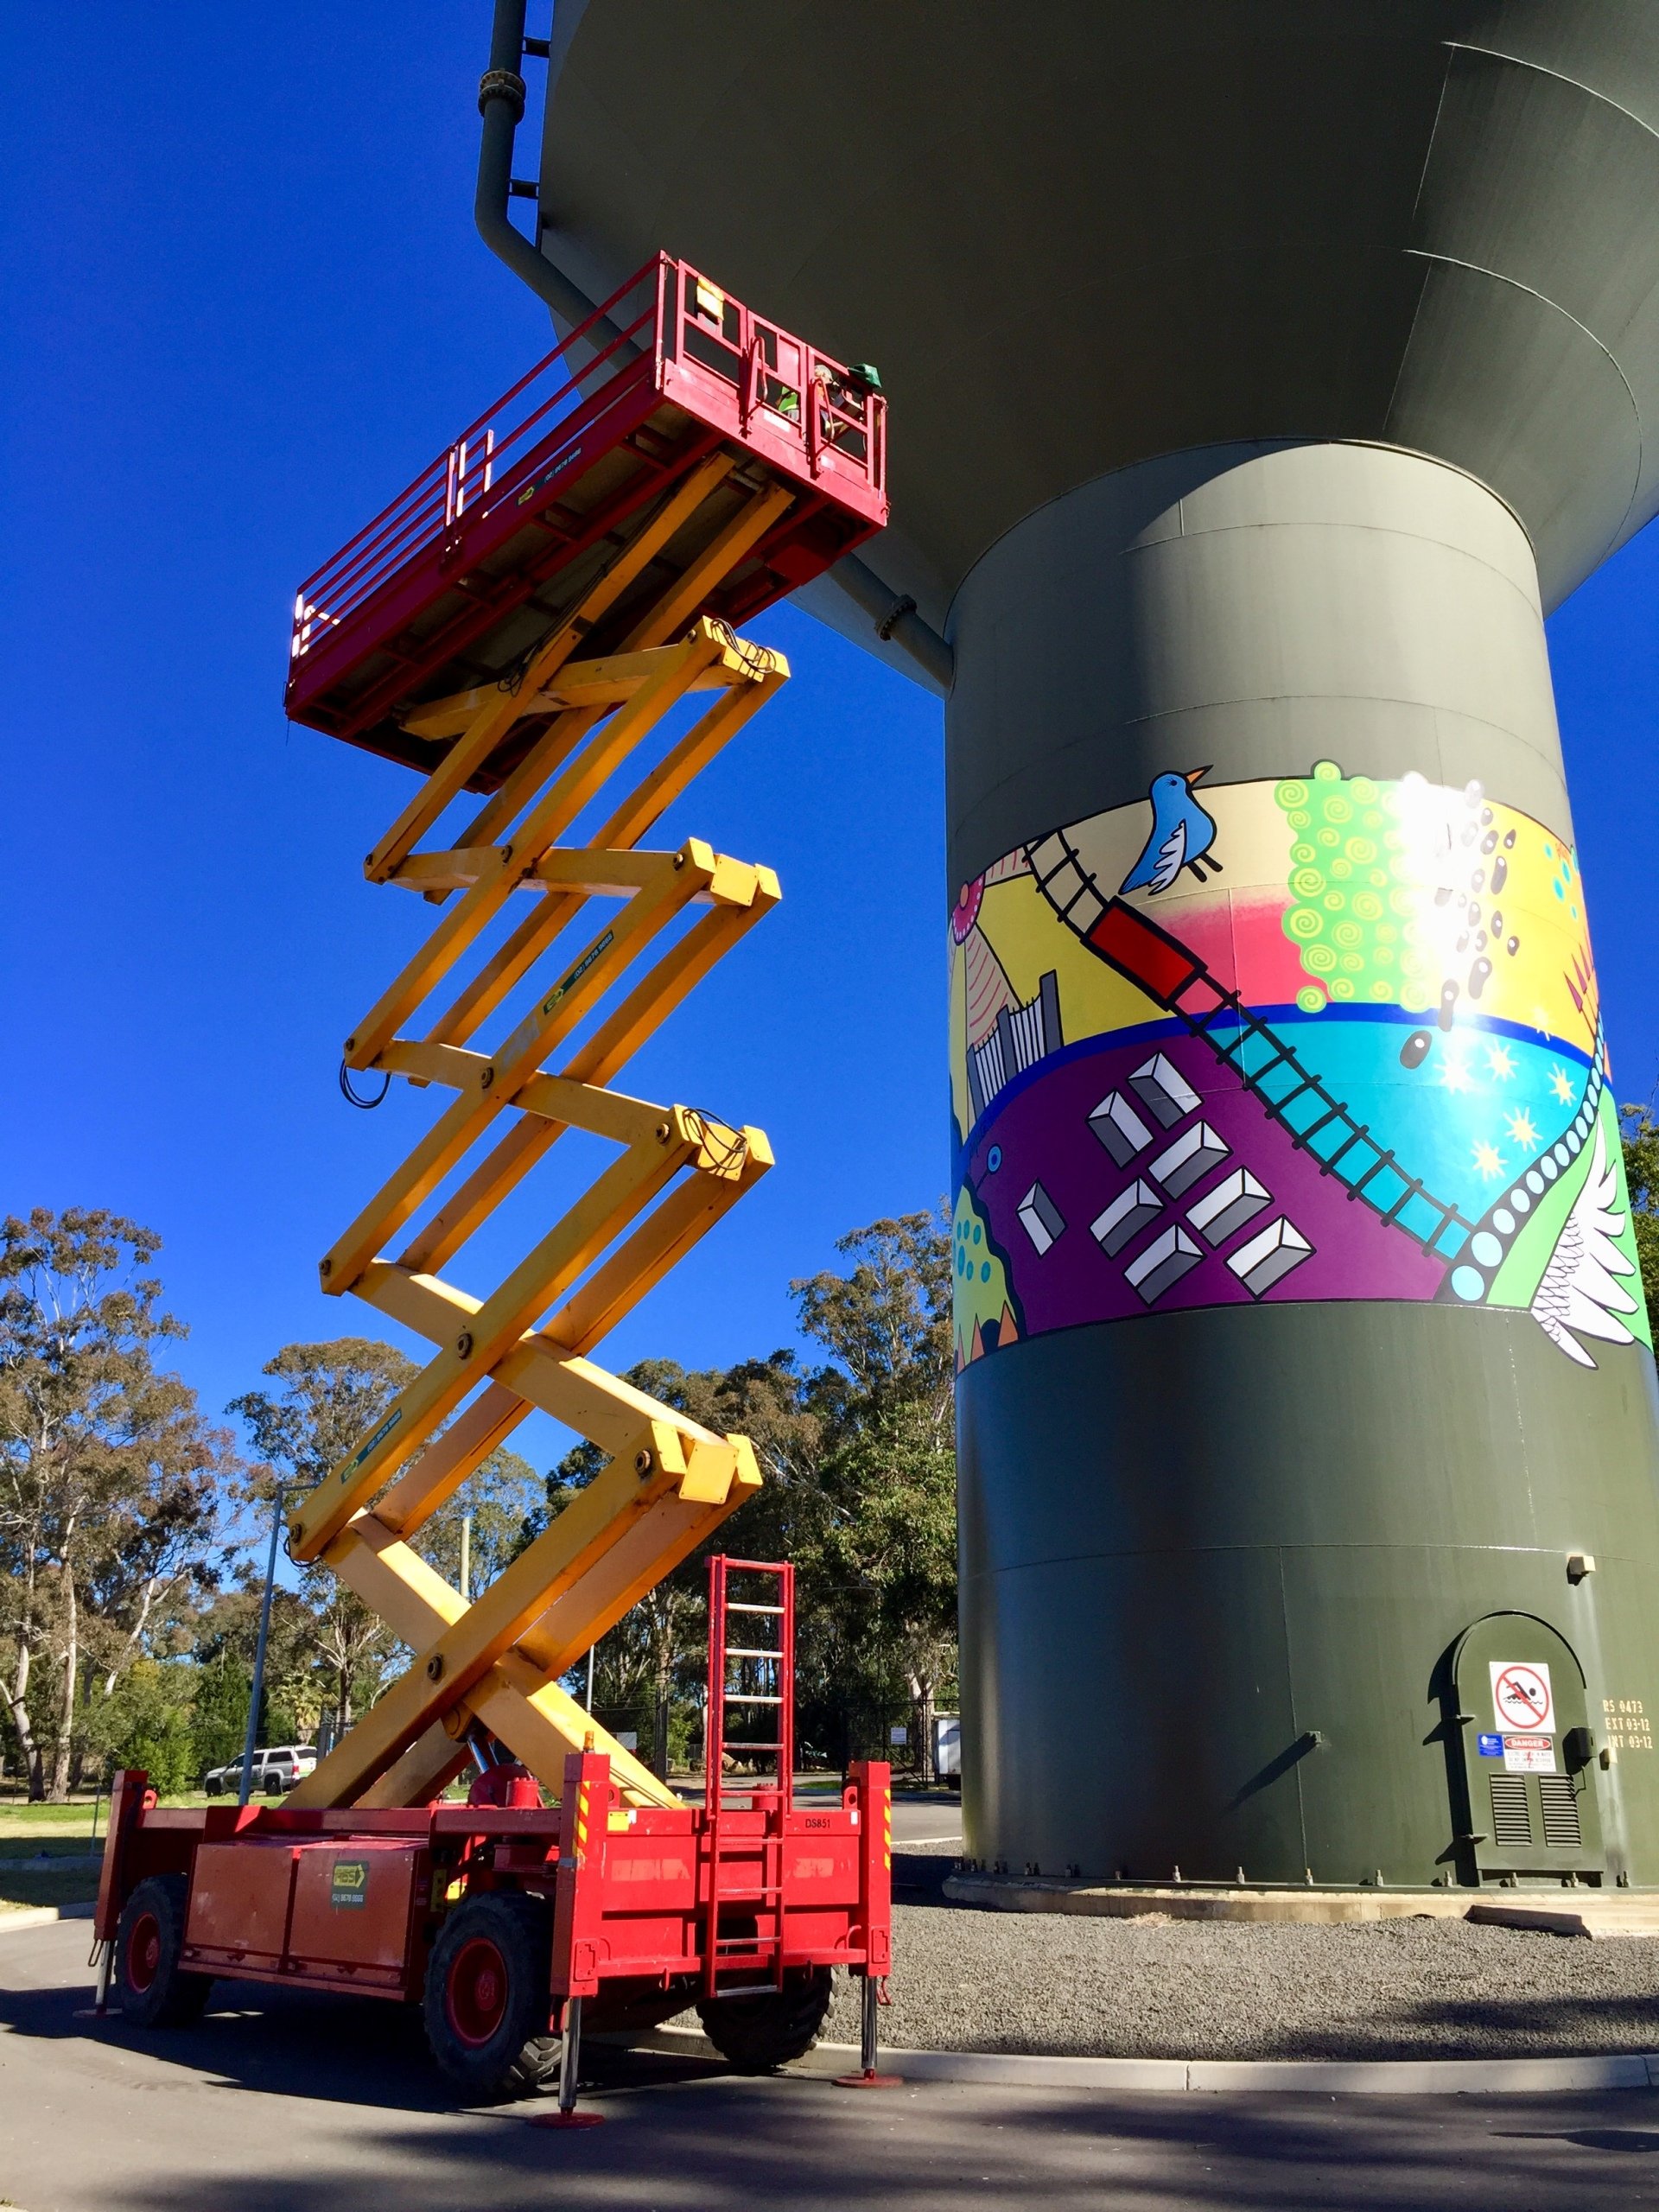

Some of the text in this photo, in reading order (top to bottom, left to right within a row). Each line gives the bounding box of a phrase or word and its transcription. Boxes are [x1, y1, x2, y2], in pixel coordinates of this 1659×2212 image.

[1603, 1700, 1643, 1713] RS 0473
[1605, 1717, 1624, 1730] EXT
[1510, 1738, 1544, 1747] DANGER
[1607, 1734, 1624, 1748] INT
[805, 1818, 830, 1828] DS851
